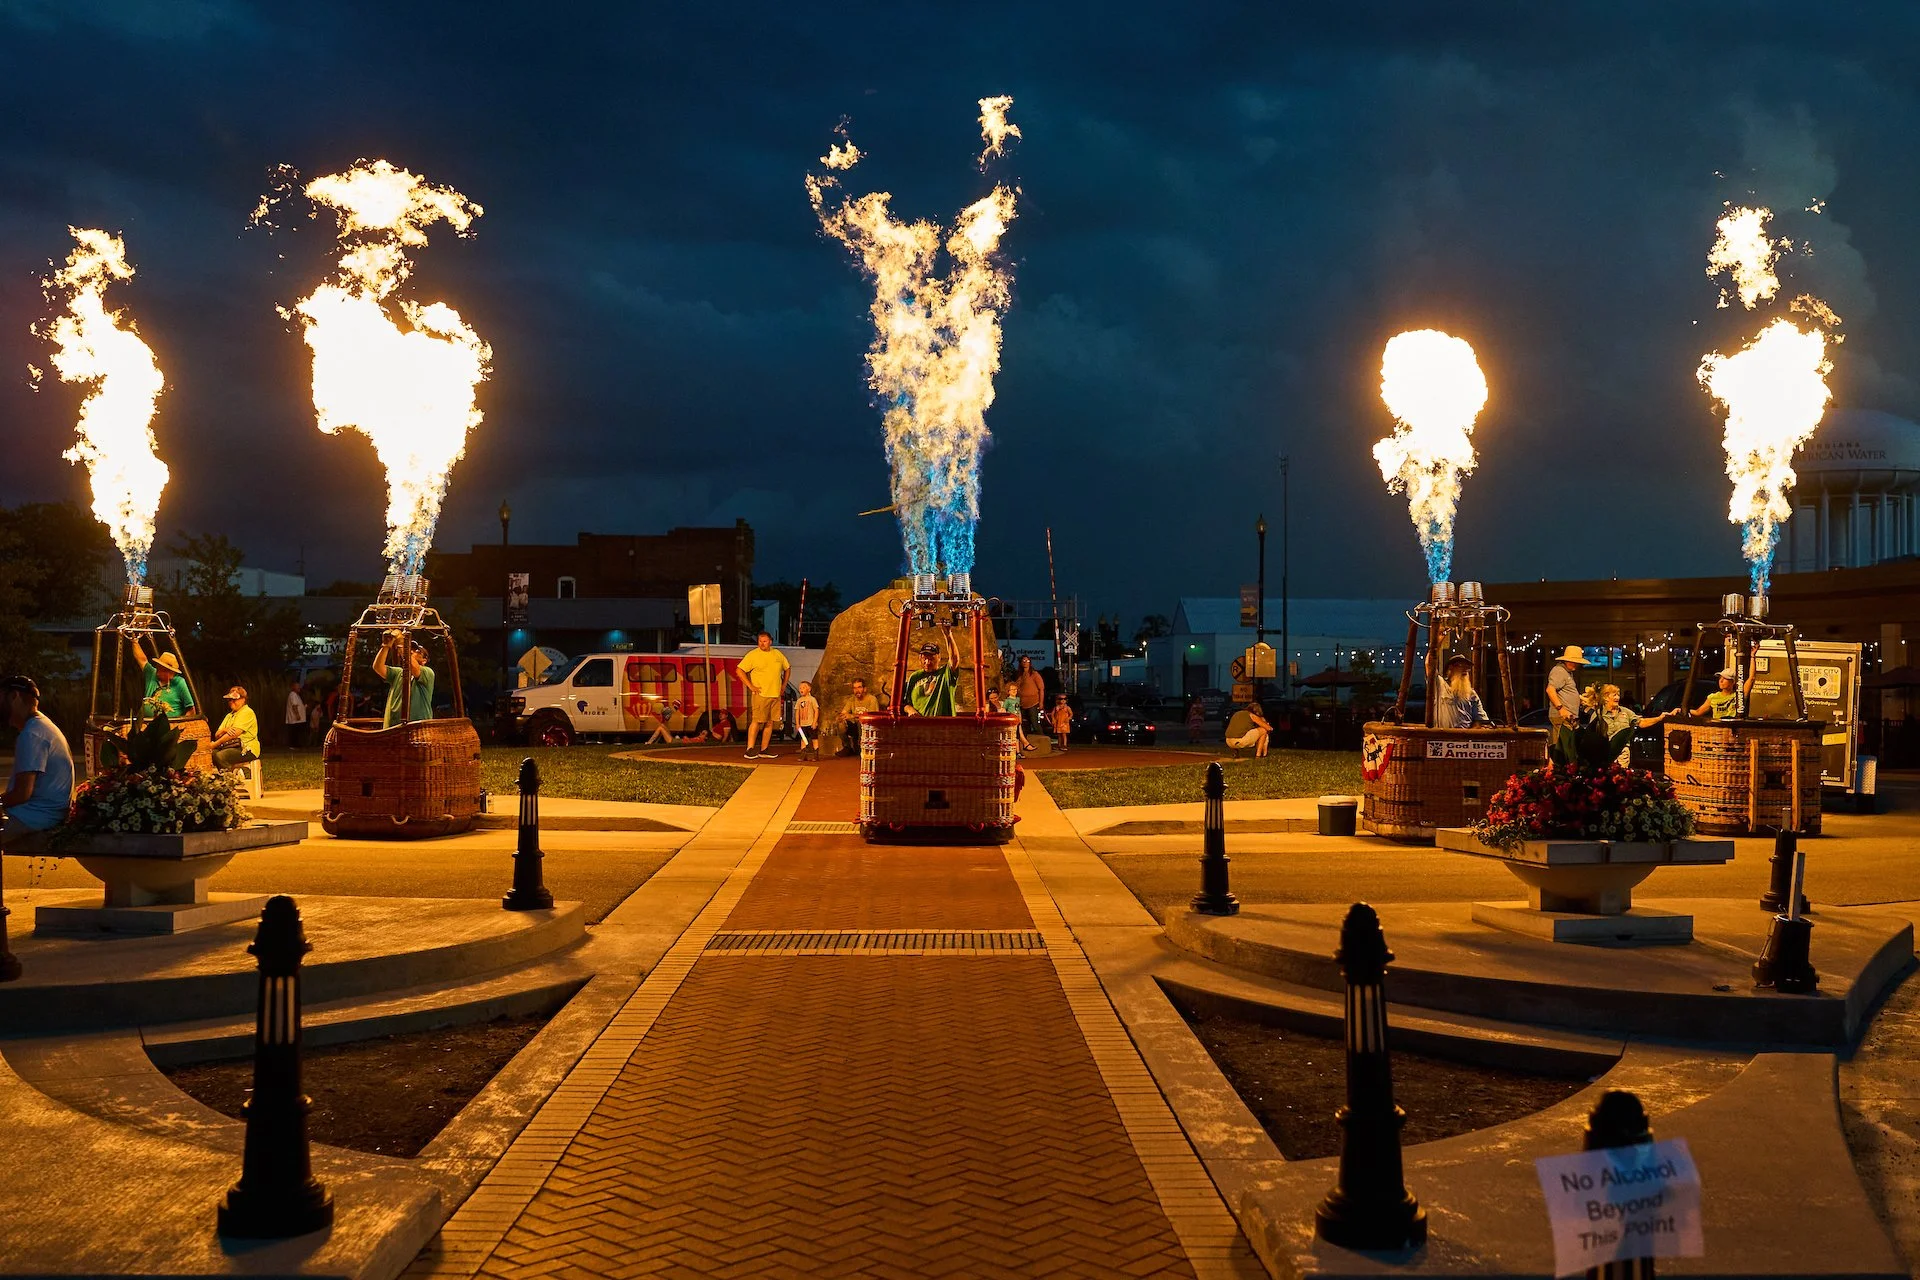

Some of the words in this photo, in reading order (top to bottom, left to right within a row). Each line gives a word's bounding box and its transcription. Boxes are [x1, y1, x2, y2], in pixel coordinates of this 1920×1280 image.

[1849, 449, 1887, 460] WATER
[1444, 750, 1505, 759] America
[1560, 1170, 1594, 1193] No
[1600, 1159, 1678, 1188] Alcohol
[1585, 1190, 1664, 1222] Beyond
[1577, 1230, 1619, 1251] This
[1624, 1215, 1676, 1239] Point
